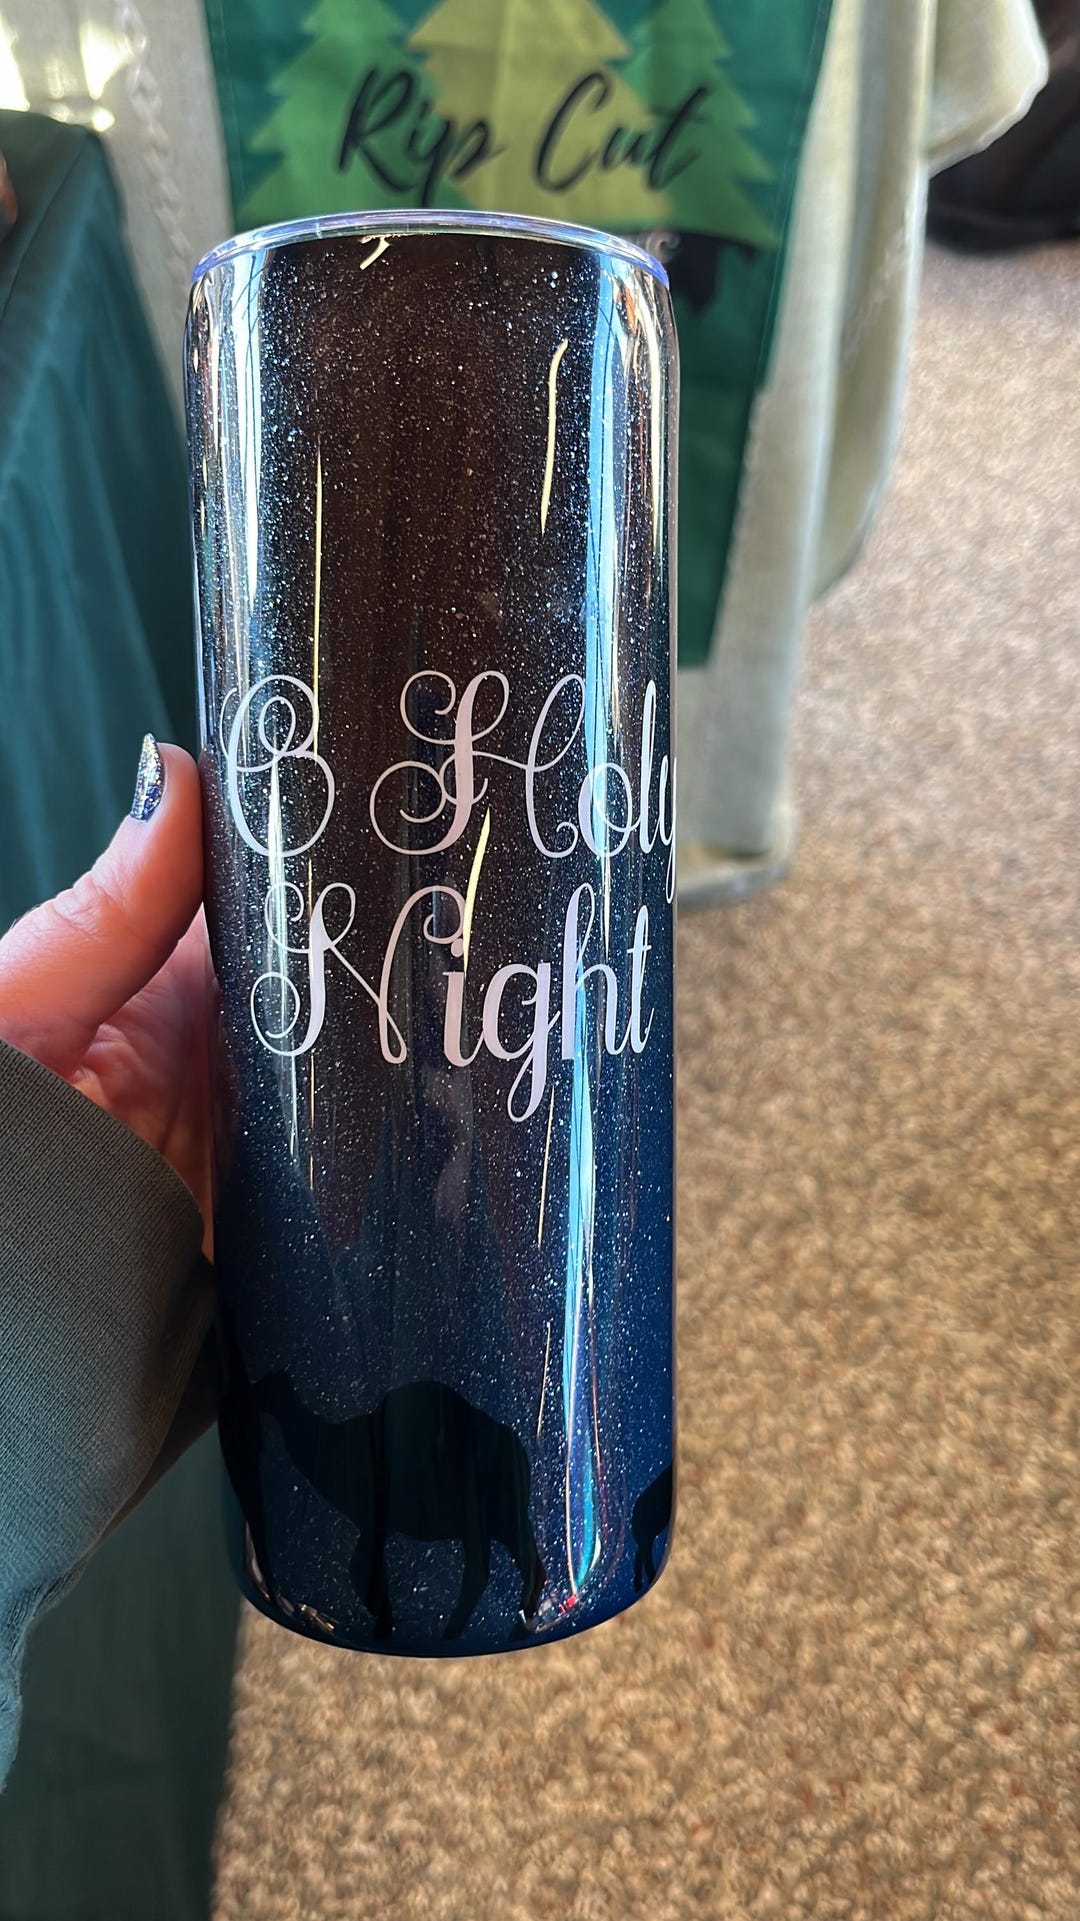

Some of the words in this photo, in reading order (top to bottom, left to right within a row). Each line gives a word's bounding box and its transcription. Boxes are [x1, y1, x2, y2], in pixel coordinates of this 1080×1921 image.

[333, 64, 507, 208] Rip
[533, 71, 710, 193] Cut
[370, 670, 678, 904] Holy
[250, 882, 655, 1123] Night
